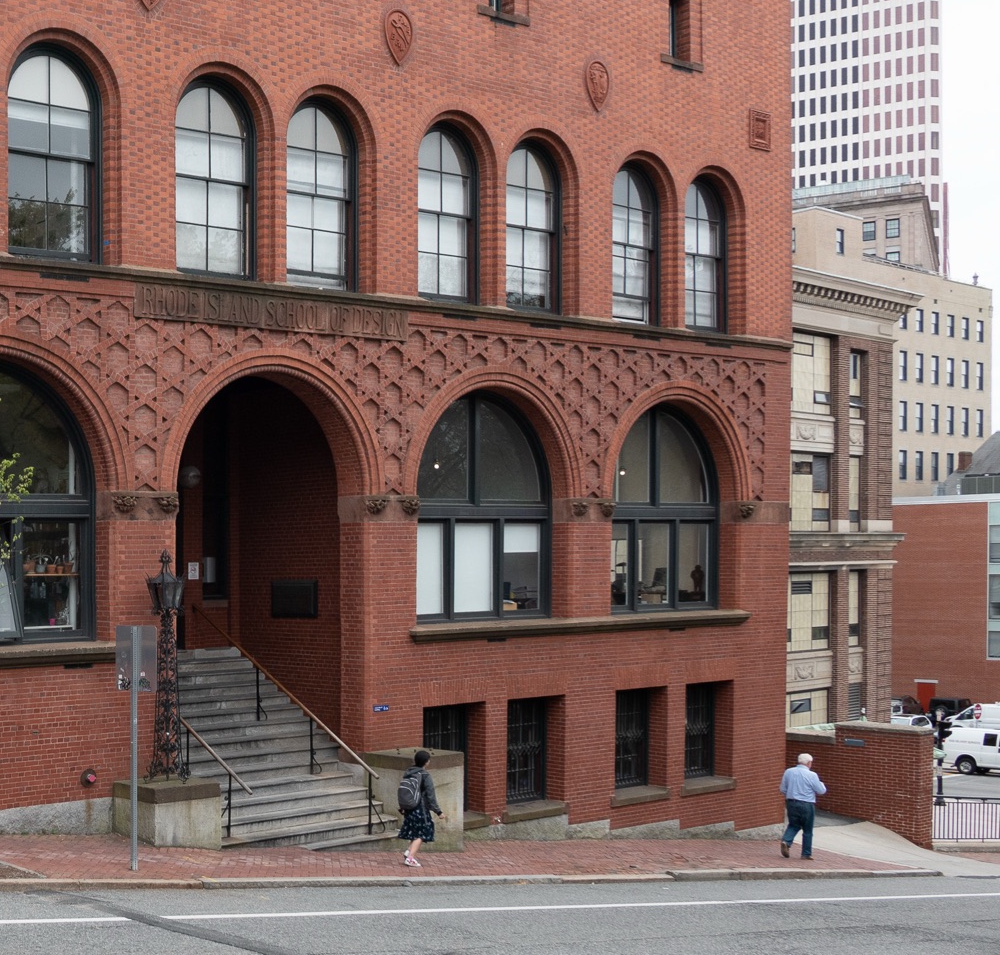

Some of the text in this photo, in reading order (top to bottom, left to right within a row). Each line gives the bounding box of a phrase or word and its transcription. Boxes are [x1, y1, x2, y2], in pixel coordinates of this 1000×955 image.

[141, 285, 405, 338] RHODE ISLAND SCHOOL OF DESIGN
